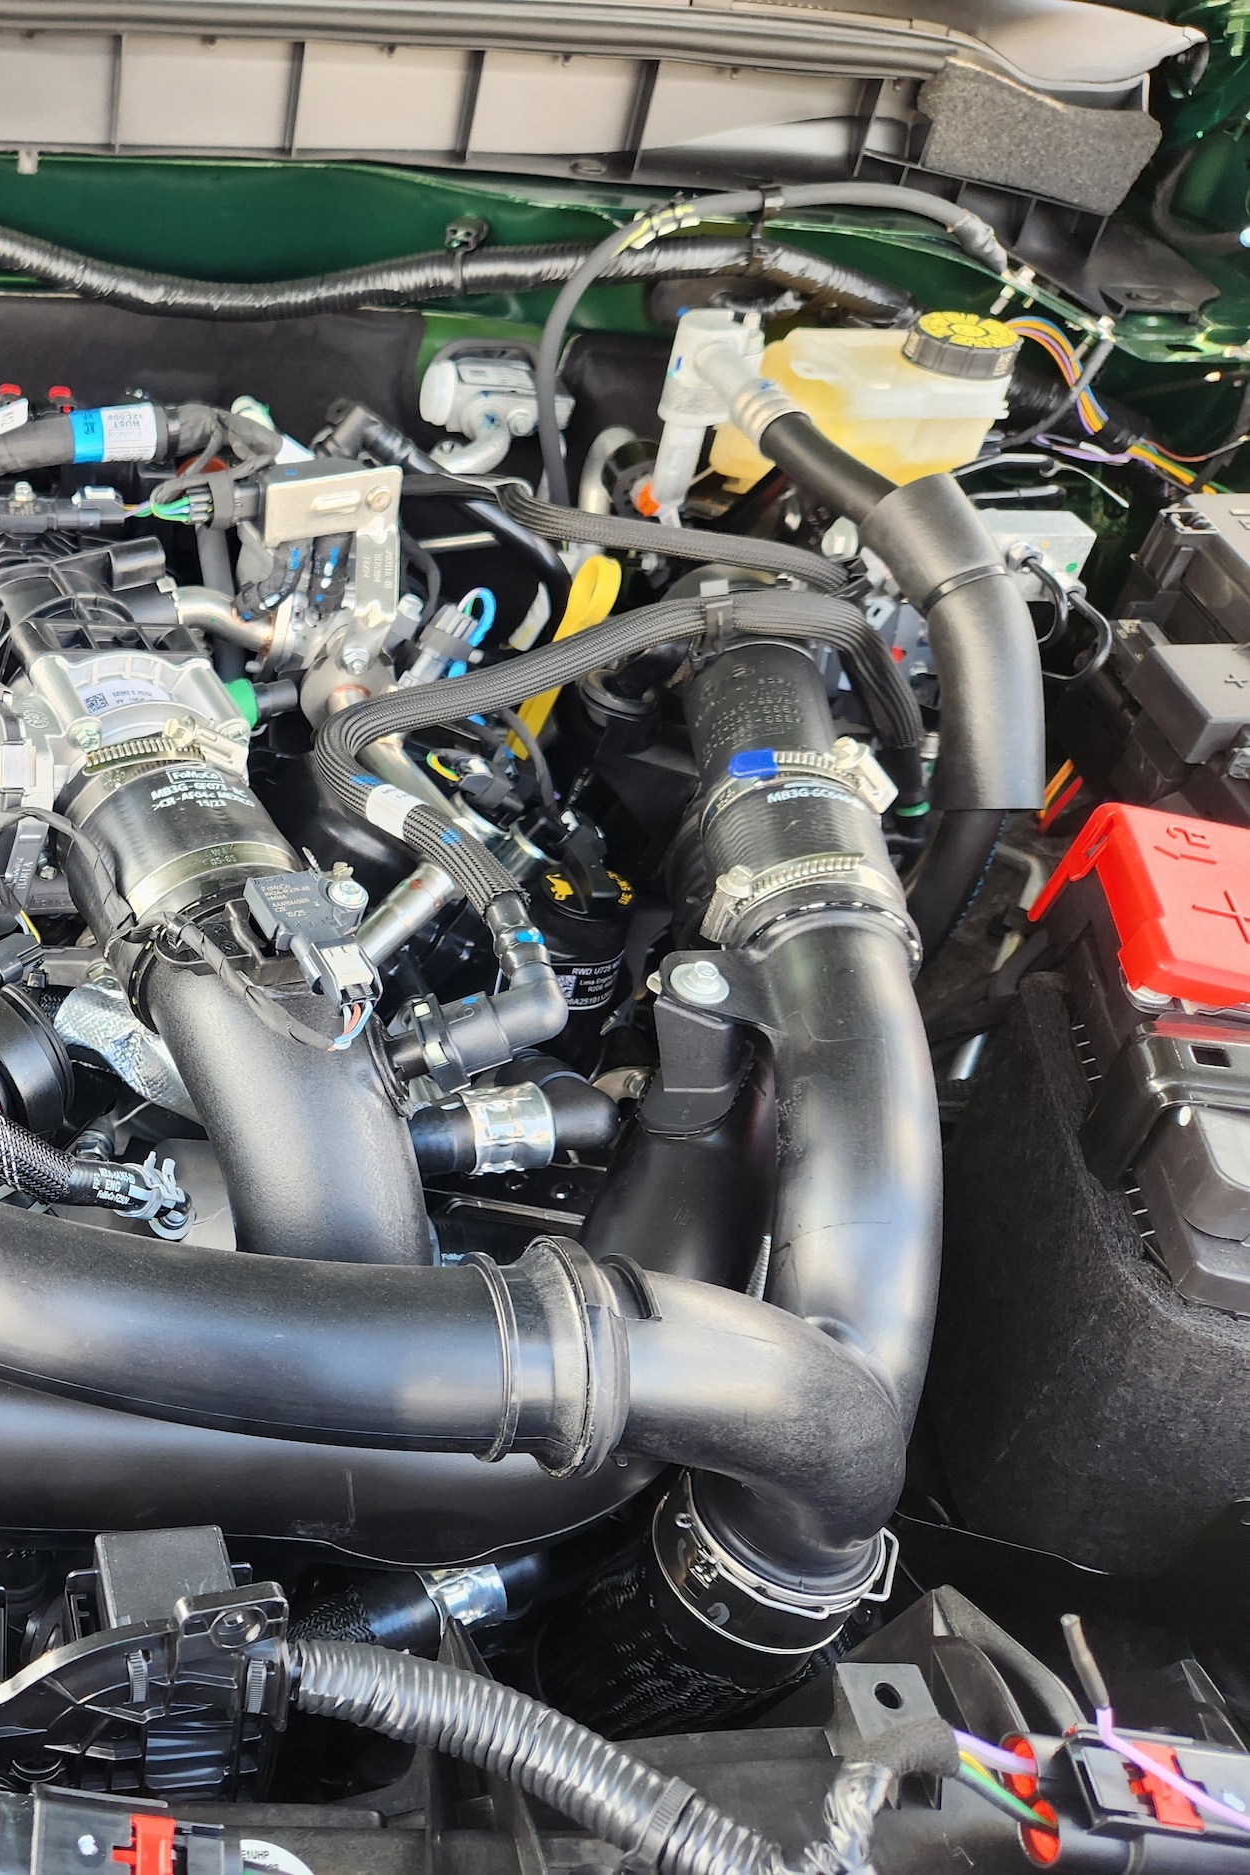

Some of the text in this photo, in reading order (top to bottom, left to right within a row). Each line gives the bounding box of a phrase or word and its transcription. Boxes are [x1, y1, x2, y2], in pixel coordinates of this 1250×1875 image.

[171, 770, 219, 780] FoMoCo
[571, 967, 593, 976] RWD
[104, 1178, 121, 1193] ENG
